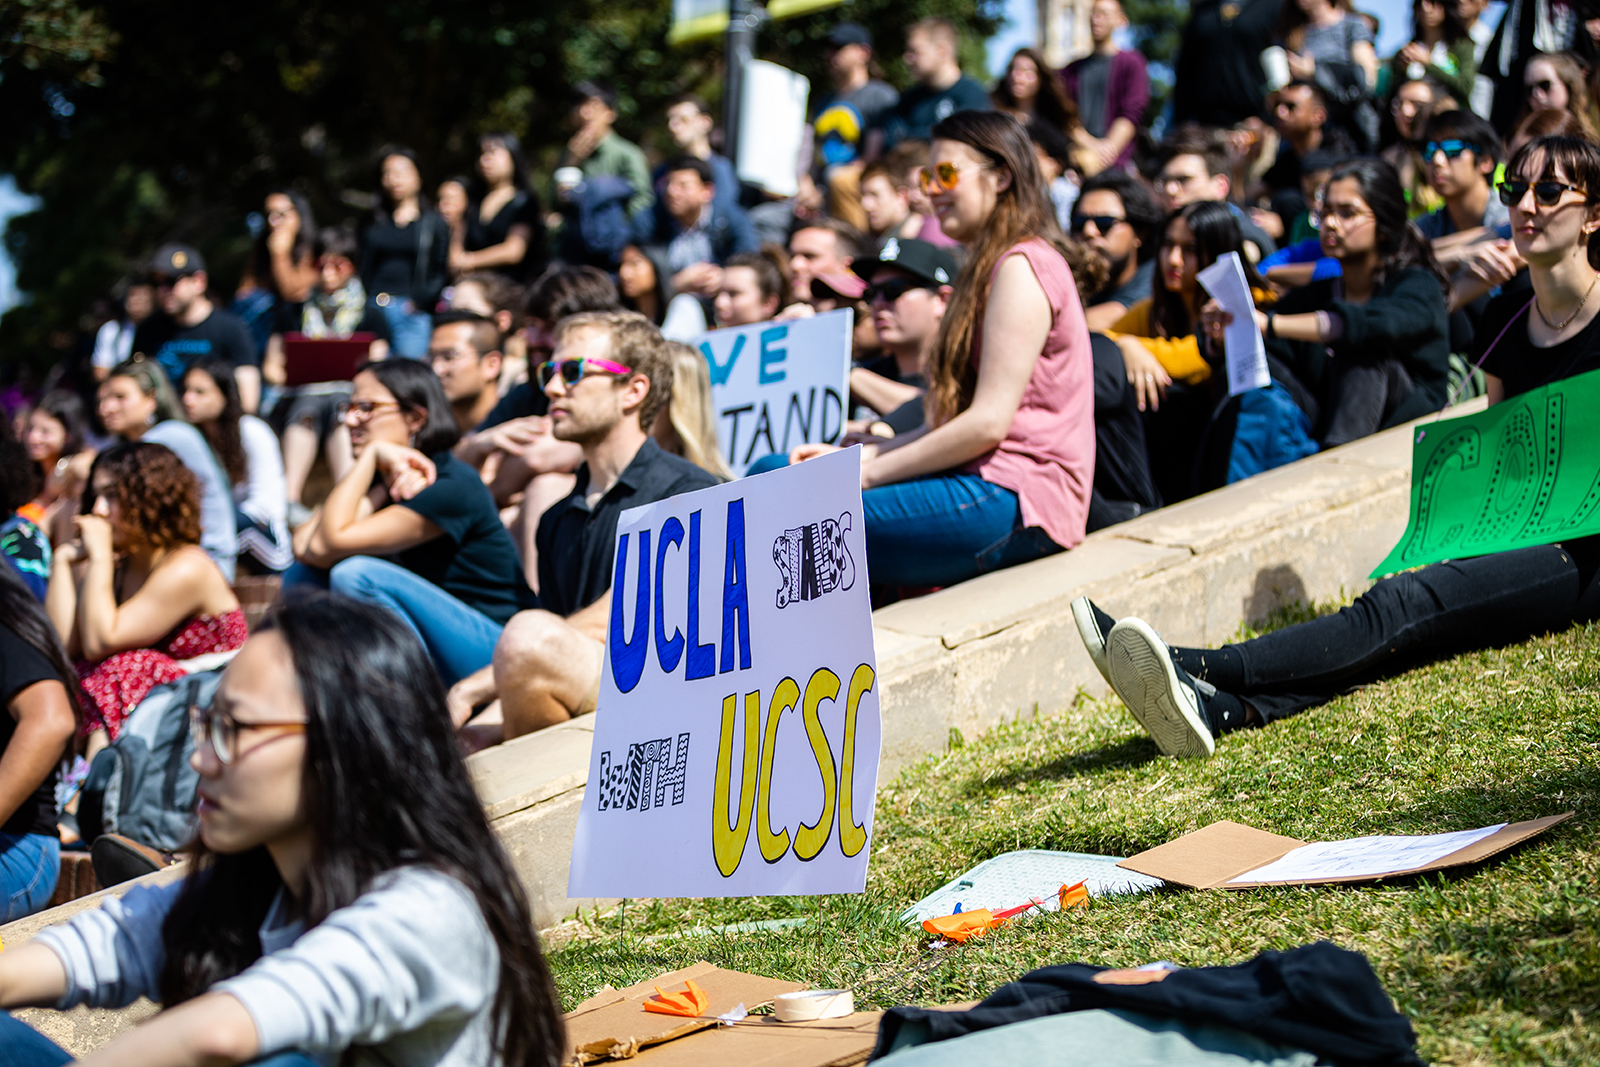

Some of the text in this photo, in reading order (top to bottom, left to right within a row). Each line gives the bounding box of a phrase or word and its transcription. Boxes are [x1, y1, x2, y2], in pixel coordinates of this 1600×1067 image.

[699, 325, 788, 386] WE
[721, 387, 843, 466] TAND
[609, 497, 855, 694] UCLA STANDS
[598, 663, 875, 878] WITH UCSC
